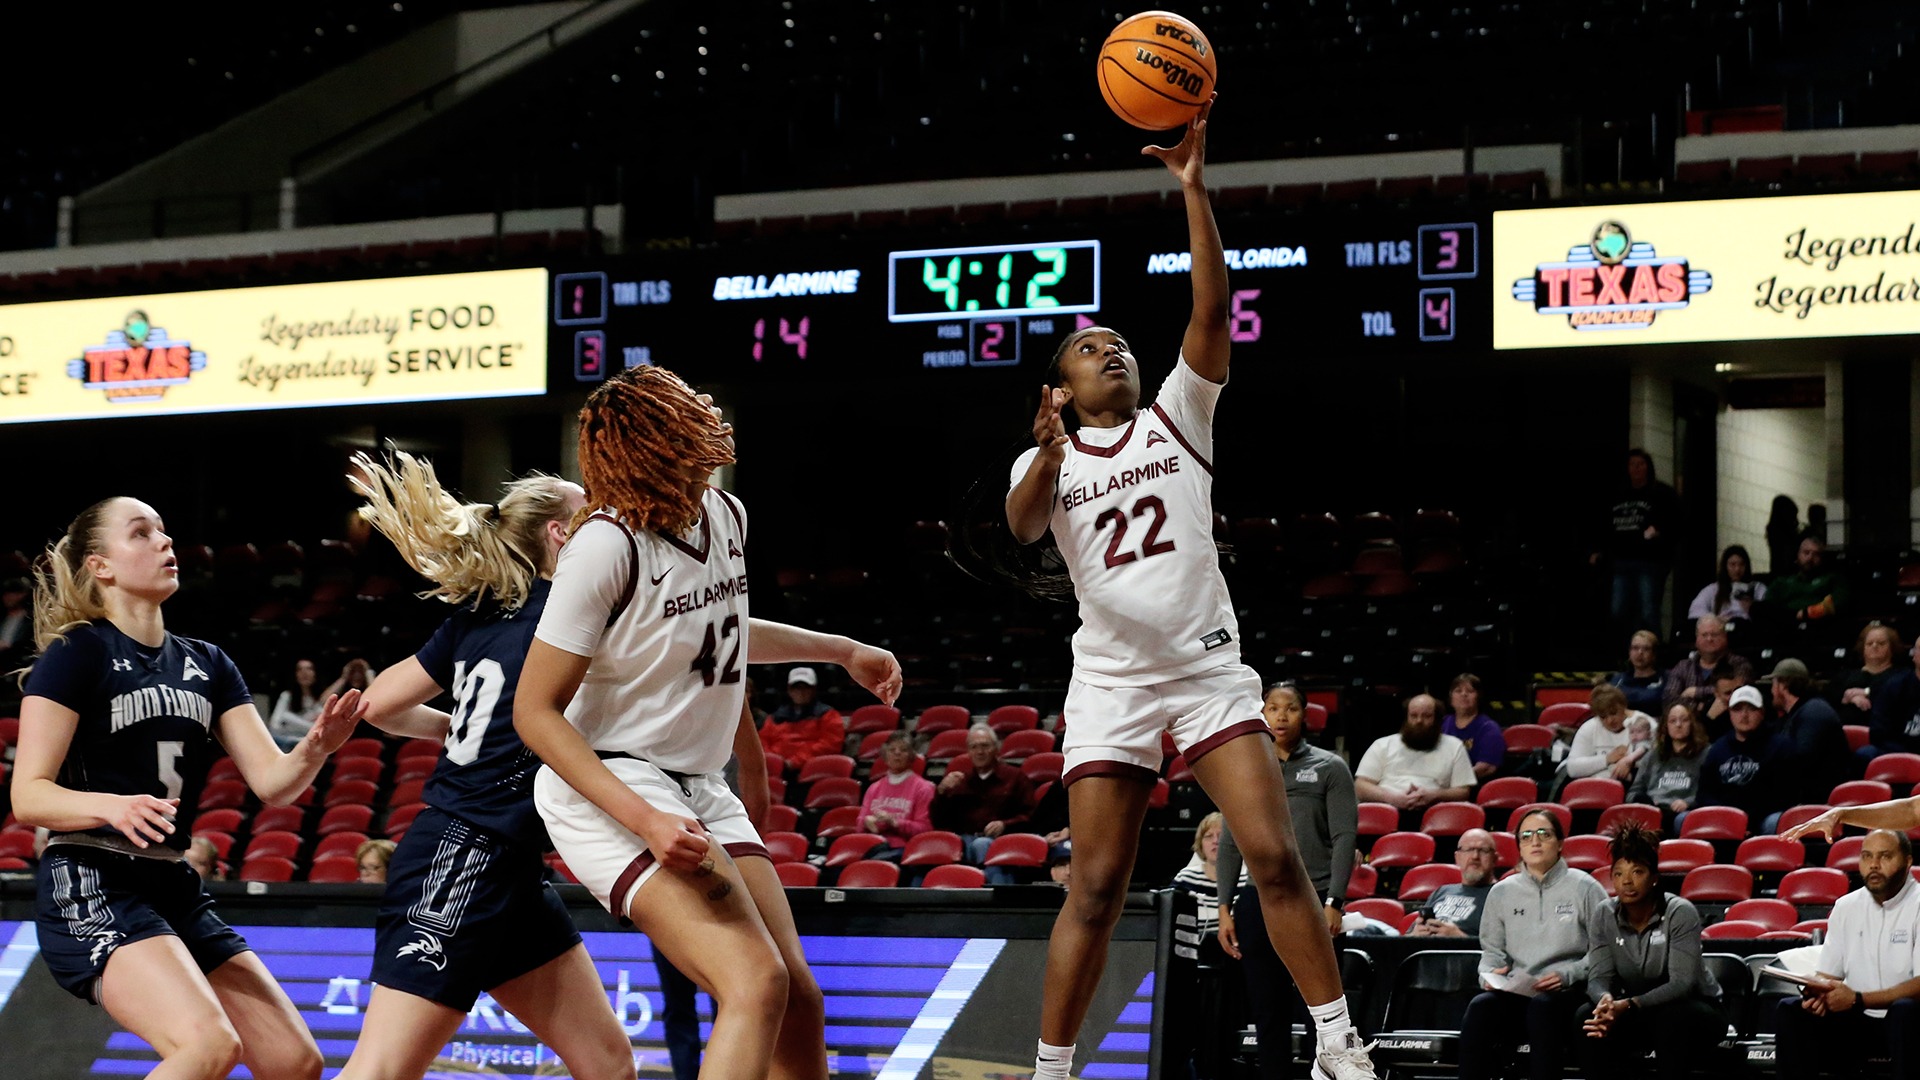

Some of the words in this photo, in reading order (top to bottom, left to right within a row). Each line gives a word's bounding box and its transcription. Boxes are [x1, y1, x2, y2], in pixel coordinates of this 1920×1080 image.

[1155, 22, 1207, 58] NCAA
[1135, 46, 1204, 98] Wilson
[1147, 252, 1192, 274] NOR
[1225, 246, 1307, 270] FLORIDA
[1345, 242, 1374, 267] TM
[1378, 241, 1412, 265] FLS
[1436, 231, 1459, 269] 3
[1784, 222, 1920, 271] Legend
[640, 280, 672, 304] FLS
[712, 269, 860, 301] BELLARMINE
[922, 247, 1067, 312] 4:12
[1541, 263, 1686, 308] TEXAS
[573, 285, 584, 315] 1
[1425, 298, 1449, 331] 4
[1569, 310, 1656, 327] ROADHOUSE
[260, 308, 400, 352] Legendary
[752, 316, 810, 361] 14
[980, 323, 1005, 360] 2
[1362, 311, 1396, 337] TOL
[84, 346, 190, 383] TEXAS
[238, 350, 378, 393] Legendary
[582, 337, 600, 371] 3
[1062, 456, 1180, 512] BELLARMINE
[1095, 495, 1176, 570] 22
[688, 614, 741, 687] 42
[110, 686, 163, 734] NORTH
[157, 741, 184, 822] 5
[450, 1041, 544, 1070] Physical
[1378, 1040, 1432, 1049] BELLARMINE
